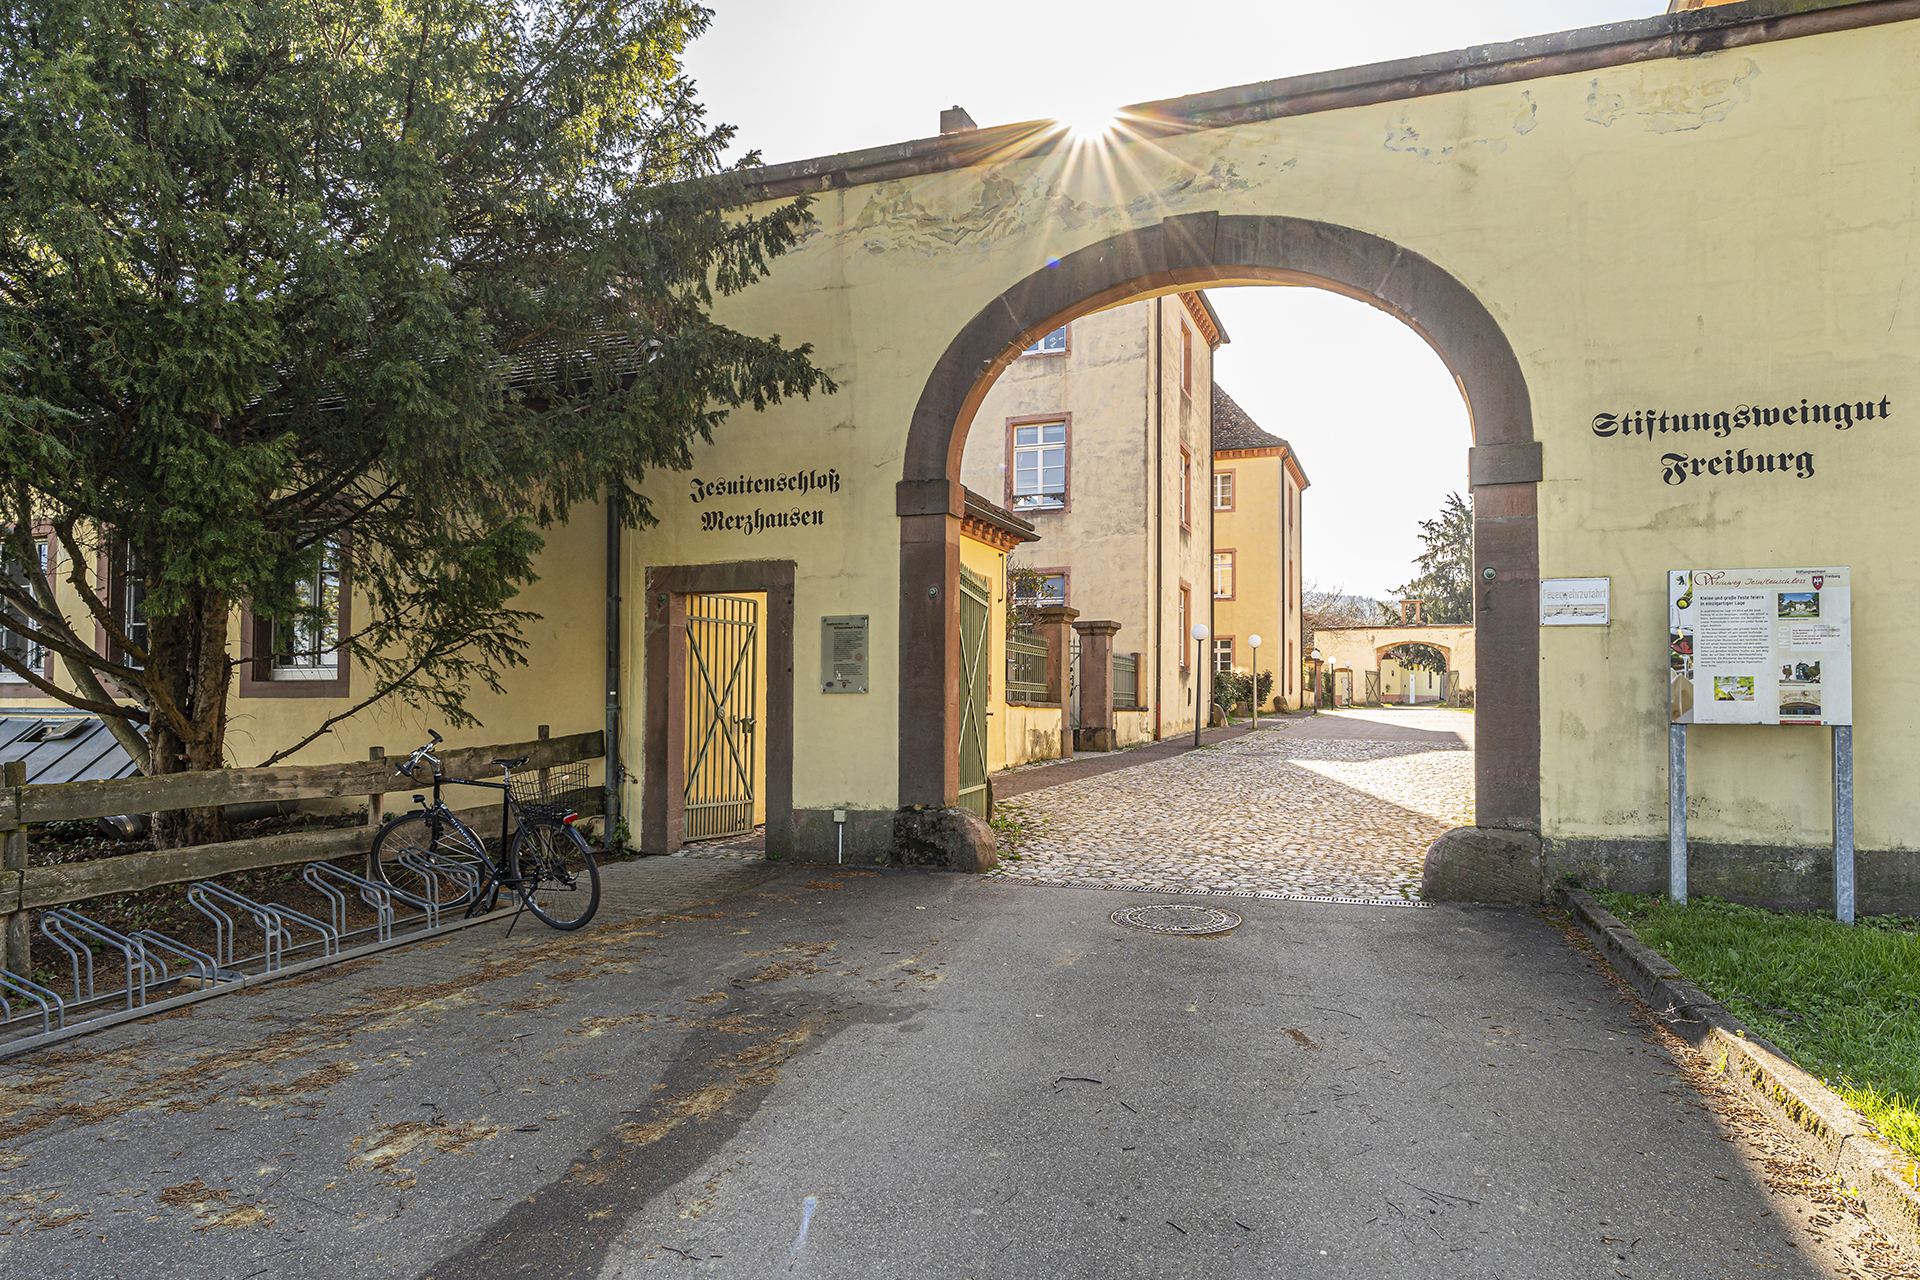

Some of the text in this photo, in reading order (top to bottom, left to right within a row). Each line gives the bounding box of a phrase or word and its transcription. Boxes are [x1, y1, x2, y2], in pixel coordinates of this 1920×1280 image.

[1591, 394, 1892, 442] Stiftungsweingut
[1660, 447, 1815, 486] Freiburg
[689, 468, 840, 503] Jesuitenschloß
[700, 507, 824, 536] Merzhausen
[1543, 588, 1606, 599] Feuerwehrzufahrt
[1694, 571, 1741, 588] Weinweg
[1778, 626, 1789, 649] INFO
